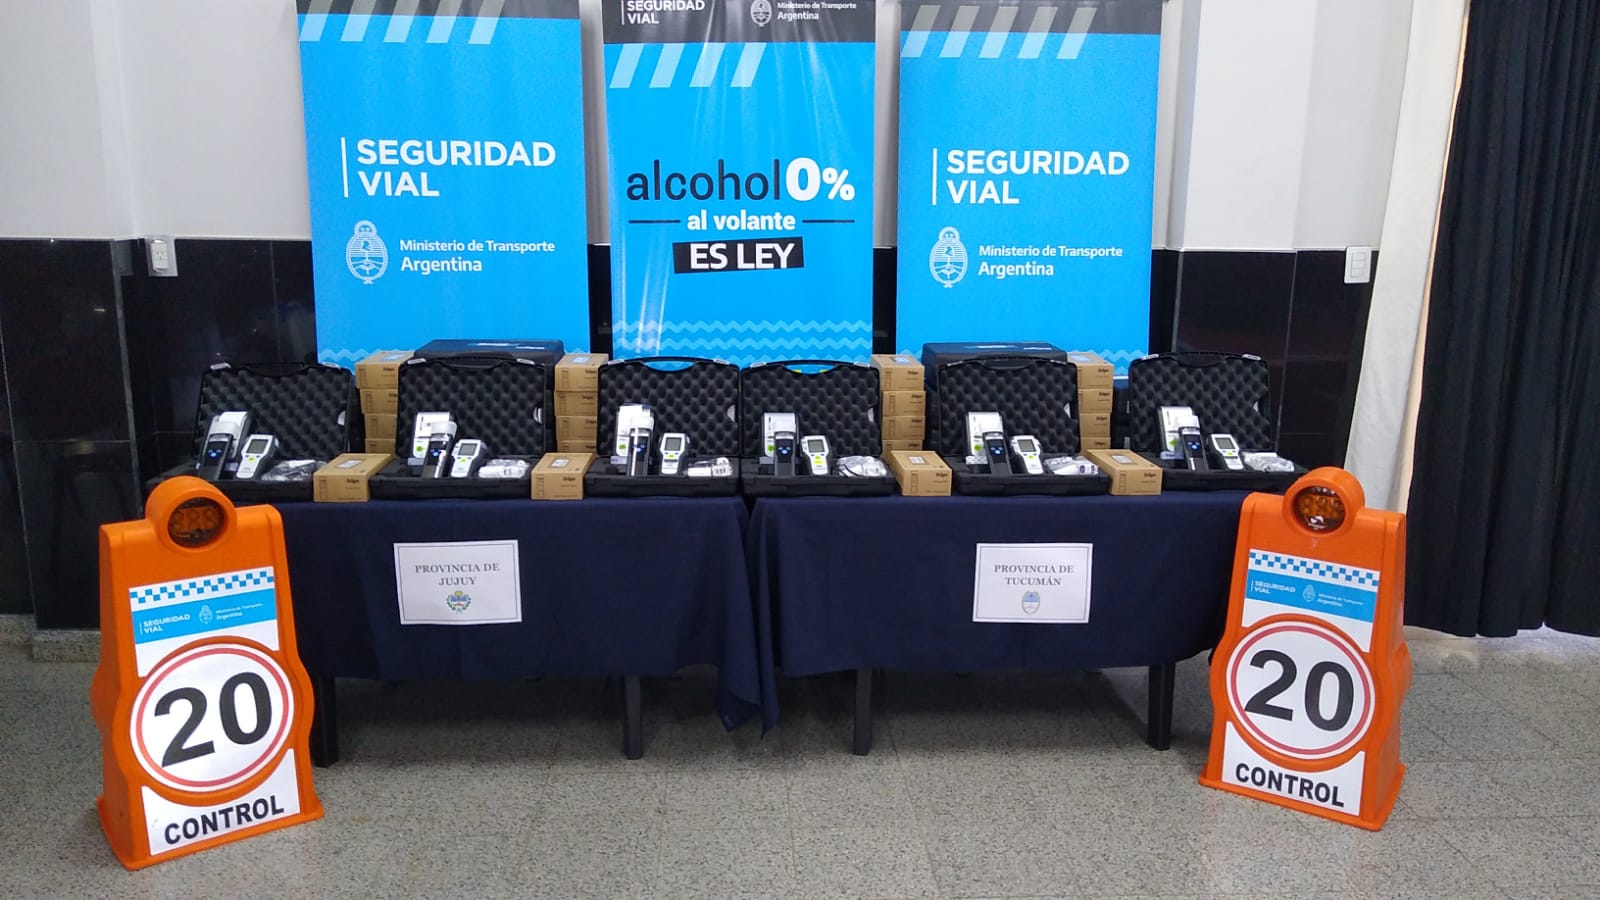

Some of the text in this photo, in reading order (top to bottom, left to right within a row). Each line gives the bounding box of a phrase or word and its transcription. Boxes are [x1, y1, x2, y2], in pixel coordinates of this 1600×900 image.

[628, 0, 705, 11] SEGURIDAD
[777, 1, 857, 10] Ministerio de Transporte
[628, 13, 660, 24] VIAL
[777, 11, 820, 21] Argentina
[357, 138, 556, 167] SEGURIDAD
[947, 149, 1130, 176] SEGURIDAD
[357, 170, 440, 197] VIAL
[626, 157, 856, 202] alcohol 0%
[946, 179, 1020, 205] VIAL
[687, 209, 796, 231] al volante
[399, 239, 556, 255] Ministerio de Transporte
[979, 244, 1123, 260] Ministerio de Transporte
[690, 242, 796, 270] ES LEY
[400, 256, 483, 275] Argentina
[978, 261, 1054, 279] Argentina
[415, 562, 500, 574] PROVINCIA DE
[993, 563, 1074, 574] PROVINCIA DE
[438, 576, 477, 586] JUJUY
[1004, 575, 1062, 586] TUCUMÁN
[1254, 580, 1296, 593] SEGURIDAD
[1254, 586, 1271, 594] VIAL
[143, 613, 191, 627] SEGURIDAD
[143, 625, 163, 634] VIAL
[1244, 649, 1354, 732] 20
[154, 671, 272, 768] 20
[1235, 763, 1345, 808] CONTROL
[164, 795, 285, 845] CONTROL
